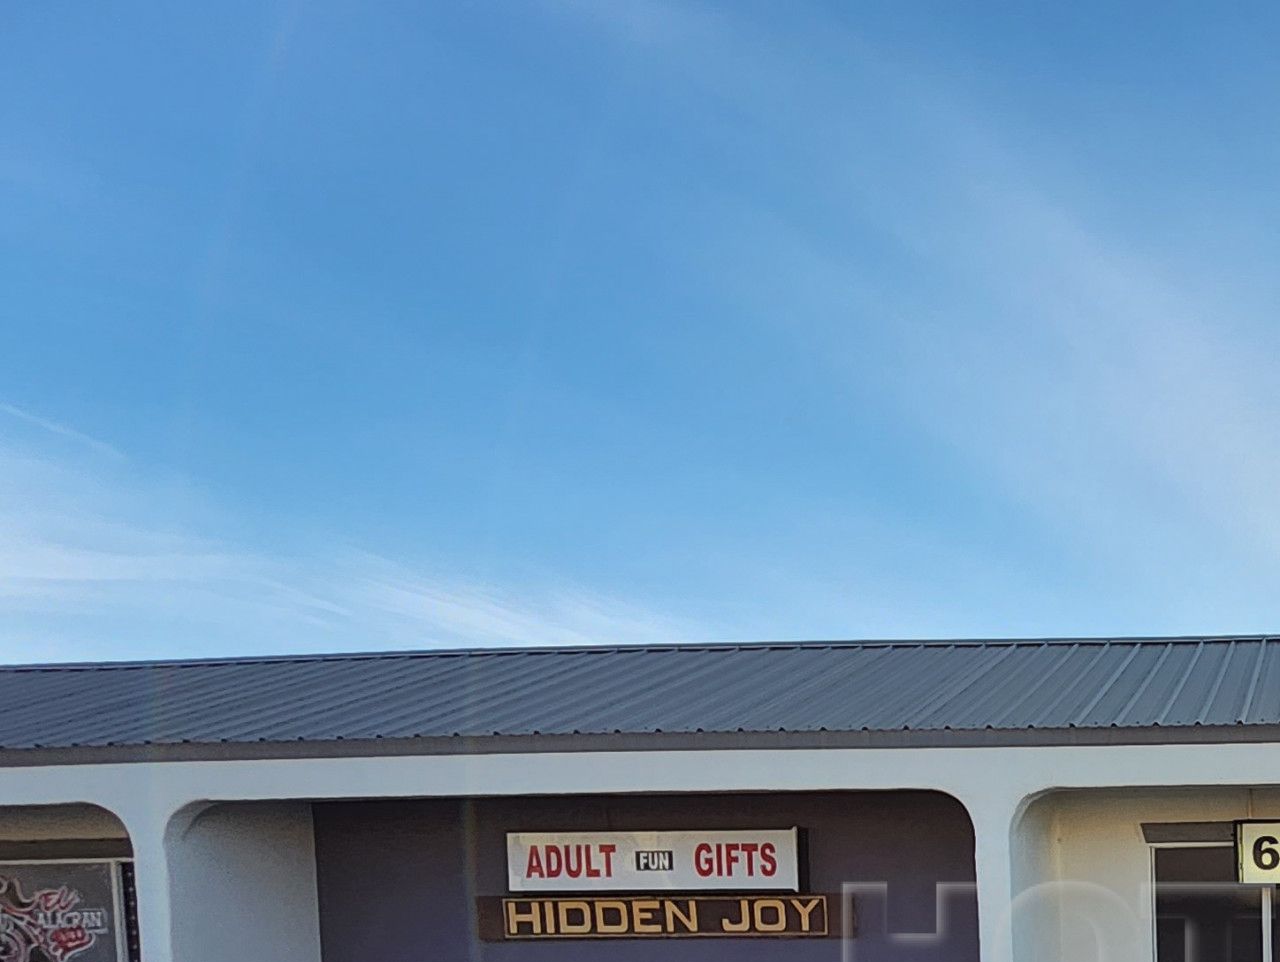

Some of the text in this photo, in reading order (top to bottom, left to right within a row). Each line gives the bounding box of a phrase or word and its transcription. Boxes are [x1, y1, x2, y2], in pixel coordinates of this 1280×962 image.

[526, 842, 778, 878] ADULT FUN GIFTS
[508, 898, 820, 934] HIDDEN JOY
